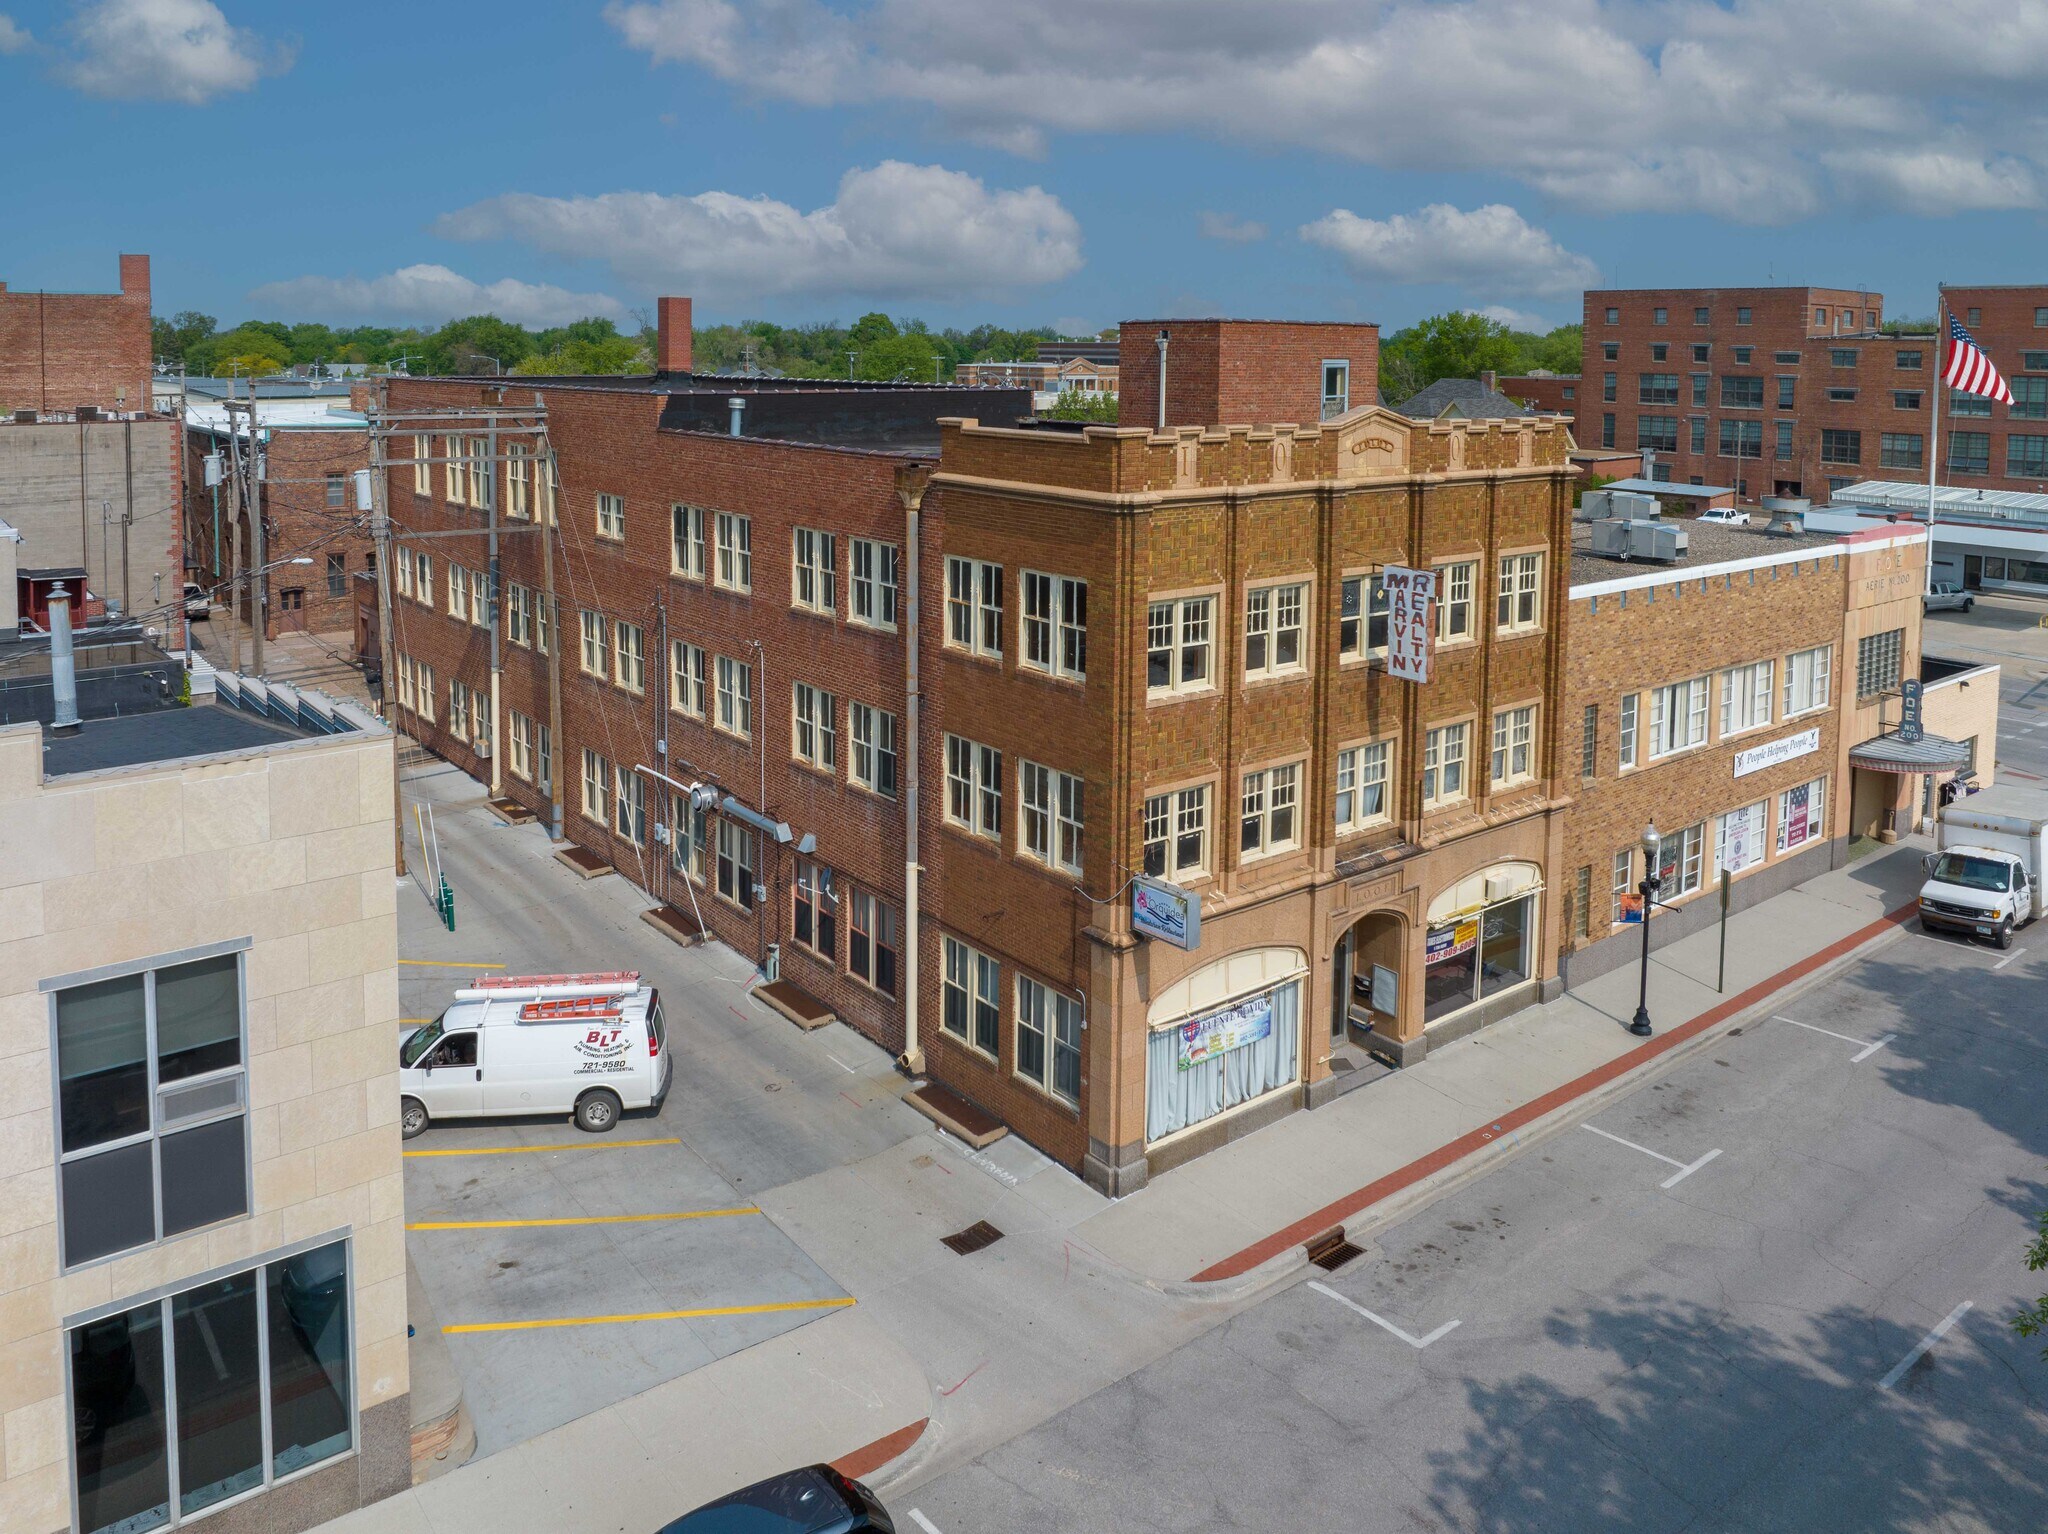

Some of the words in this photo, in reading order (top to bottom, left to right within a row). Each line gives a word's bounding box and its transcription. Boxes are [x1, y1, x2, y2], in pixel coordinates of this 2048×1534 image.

[1386, 573, 1409, 671] MARVIN
[1410, 574, 1430, 673] REALTY
[1900, 730, 1919, 740] 200
[1746, 748, 1767, 764] People
[1767, 743, 1789, 758] Helping
[1789, 735, 1808, 751] People
[1149, 898, 1184, 921] Orquidea
[586, 1030, 622, 1047] BLT
[573, 1044, 581, 1053] AIR
[583, 1050, 622, 1059] CONDITIONING
[582, 1060, 626, 1070] 721-9580
